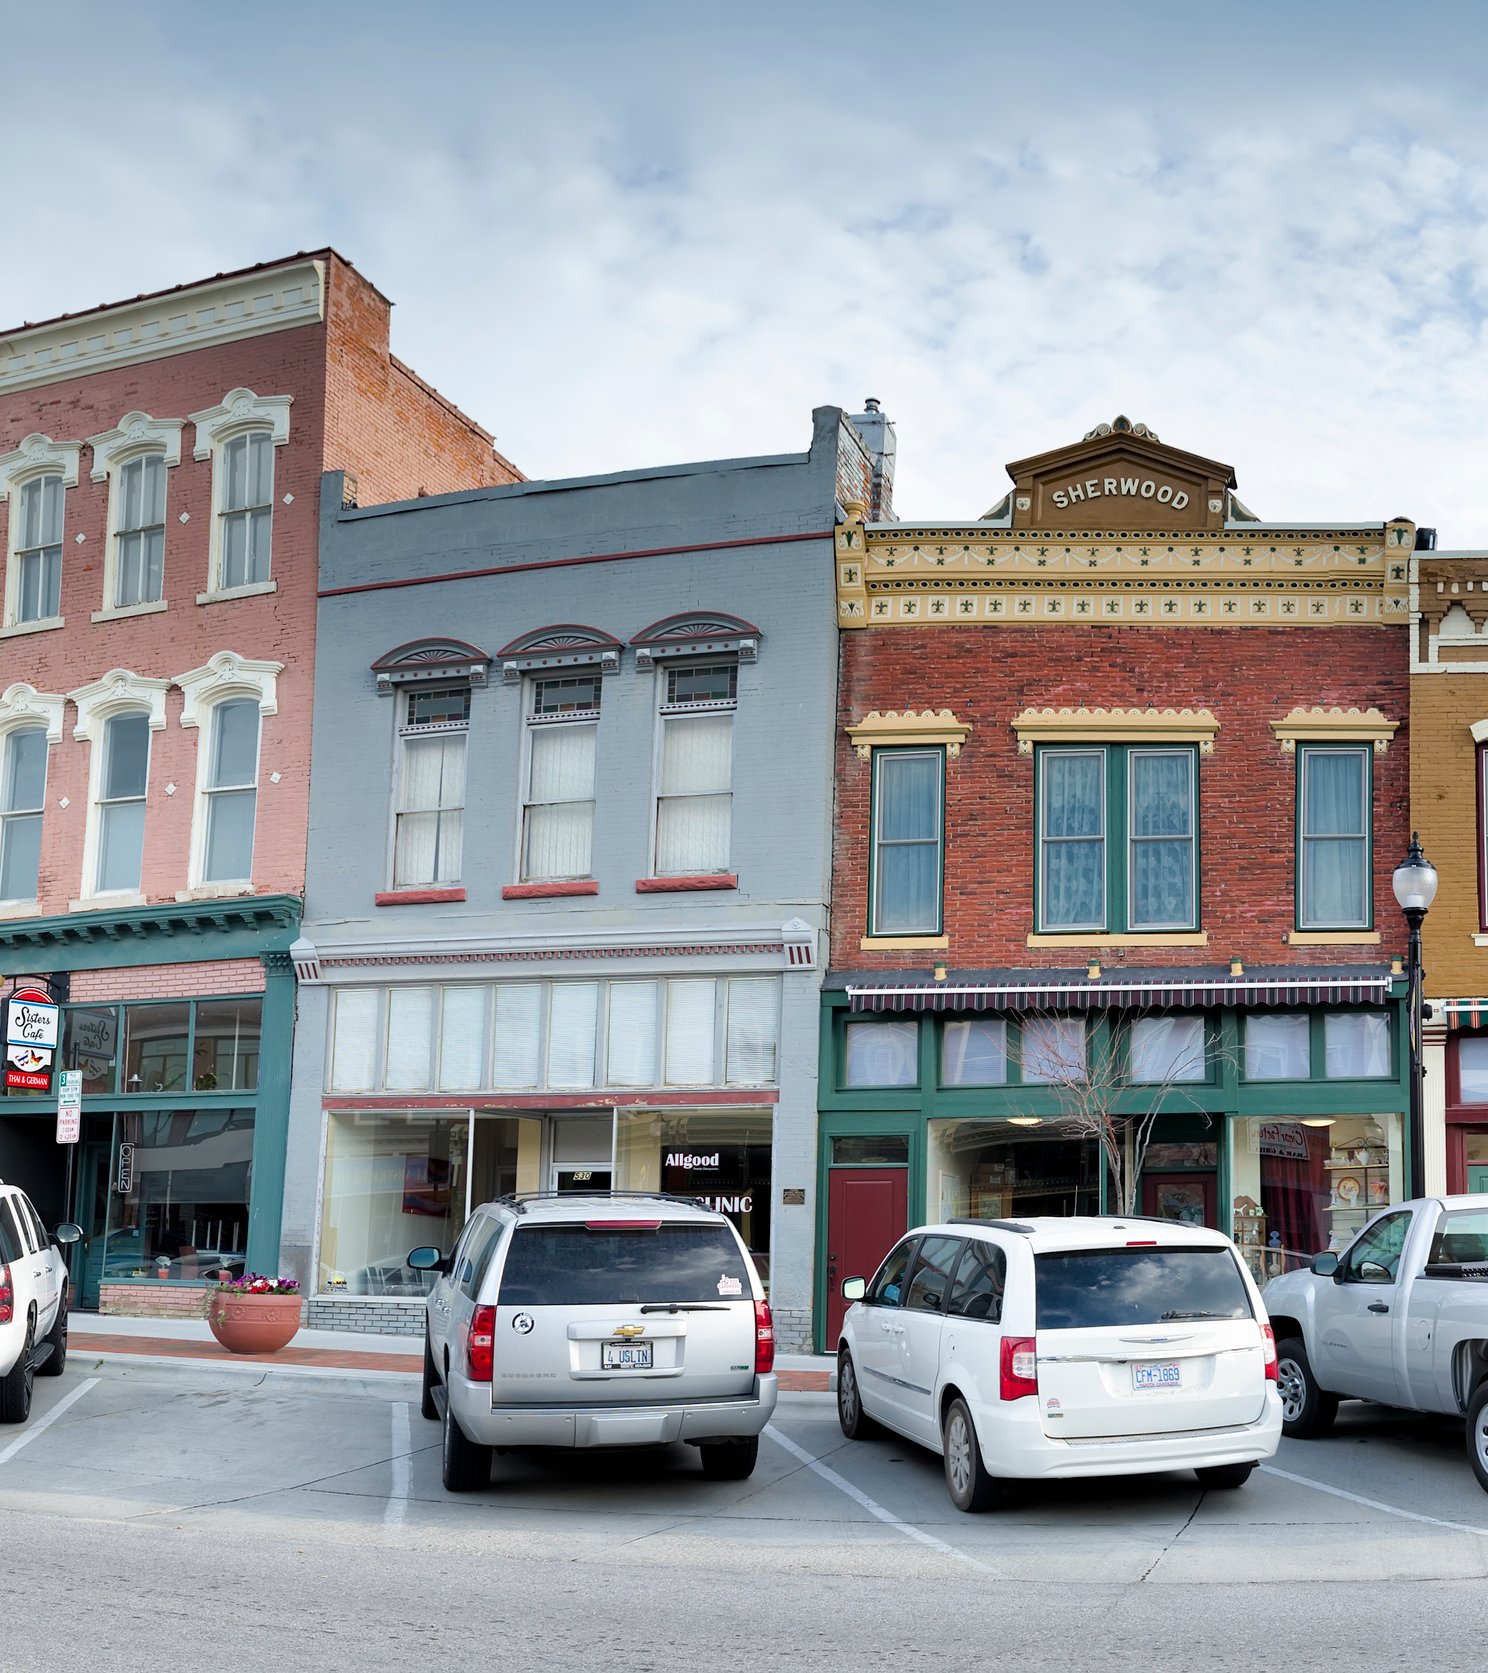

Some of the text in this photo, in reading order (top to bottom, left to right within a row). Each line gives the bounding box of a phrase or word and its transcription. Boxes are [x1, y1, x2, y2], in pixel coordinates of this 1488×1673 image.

[1052, 475, 1190, 511] SHERWOOD
[15, 1006, 51, 1027] Sisters
[8, 1074, 48, 1085] THAI & GERMAN
[61, 1073, 66, 1086] 3
[121, 1145, 132, 1190] OPEN
[665, 1153, 719, 1169] Allgood
[574, 1172, 591, 1181] 530
[607, 1349, 649, 1364] 4 USLTN
[1136, 1366, 1181, 1384] CFM-1869
